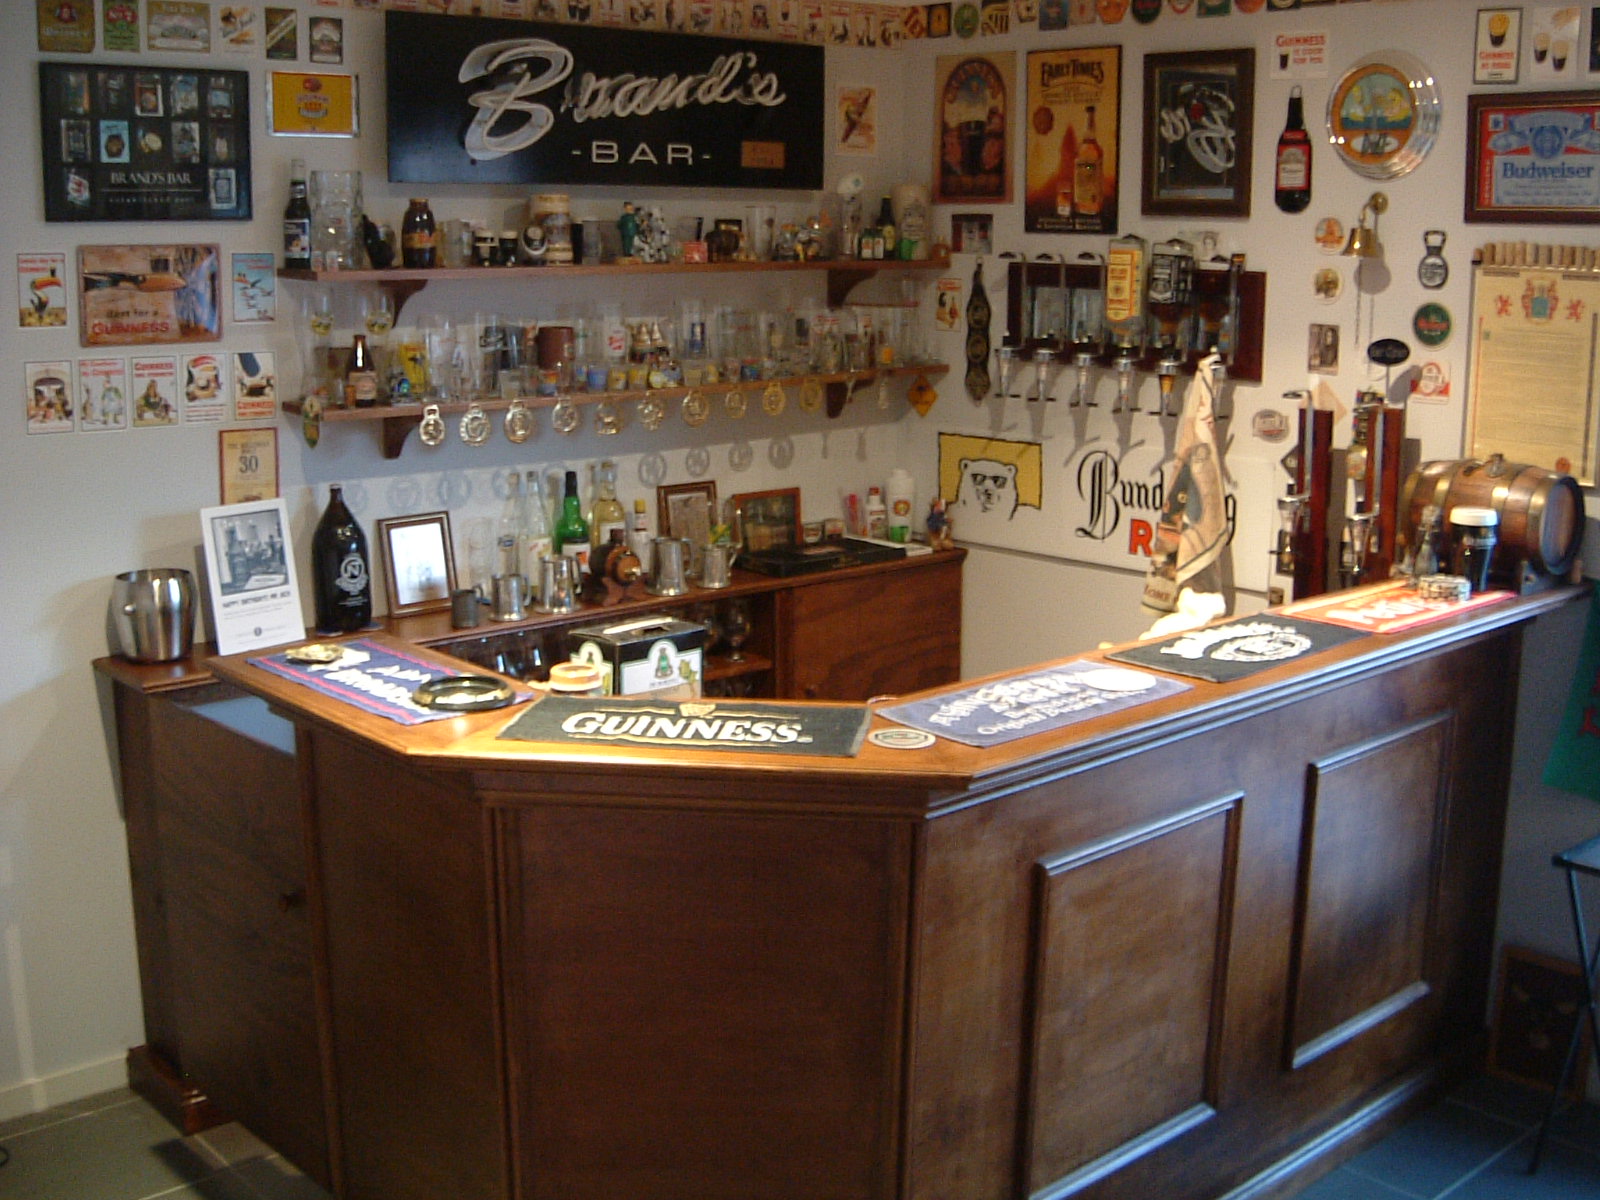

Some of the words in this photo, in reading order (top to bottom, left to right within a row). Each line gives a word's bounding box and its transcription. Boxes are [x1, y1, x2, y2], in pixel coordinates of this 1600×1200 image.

[458, 38, 786, 160] Brand's
[590, 140, 694, 166] BAR
[1502, 161, 1594, 179] Budweiser
[92, 320, 170, 335] GUINNESS
[238, 455, 259, 474] 30
[1075, 450, 1237, 546] Bundg
[561, 712, 803, 744] GUINNESS
